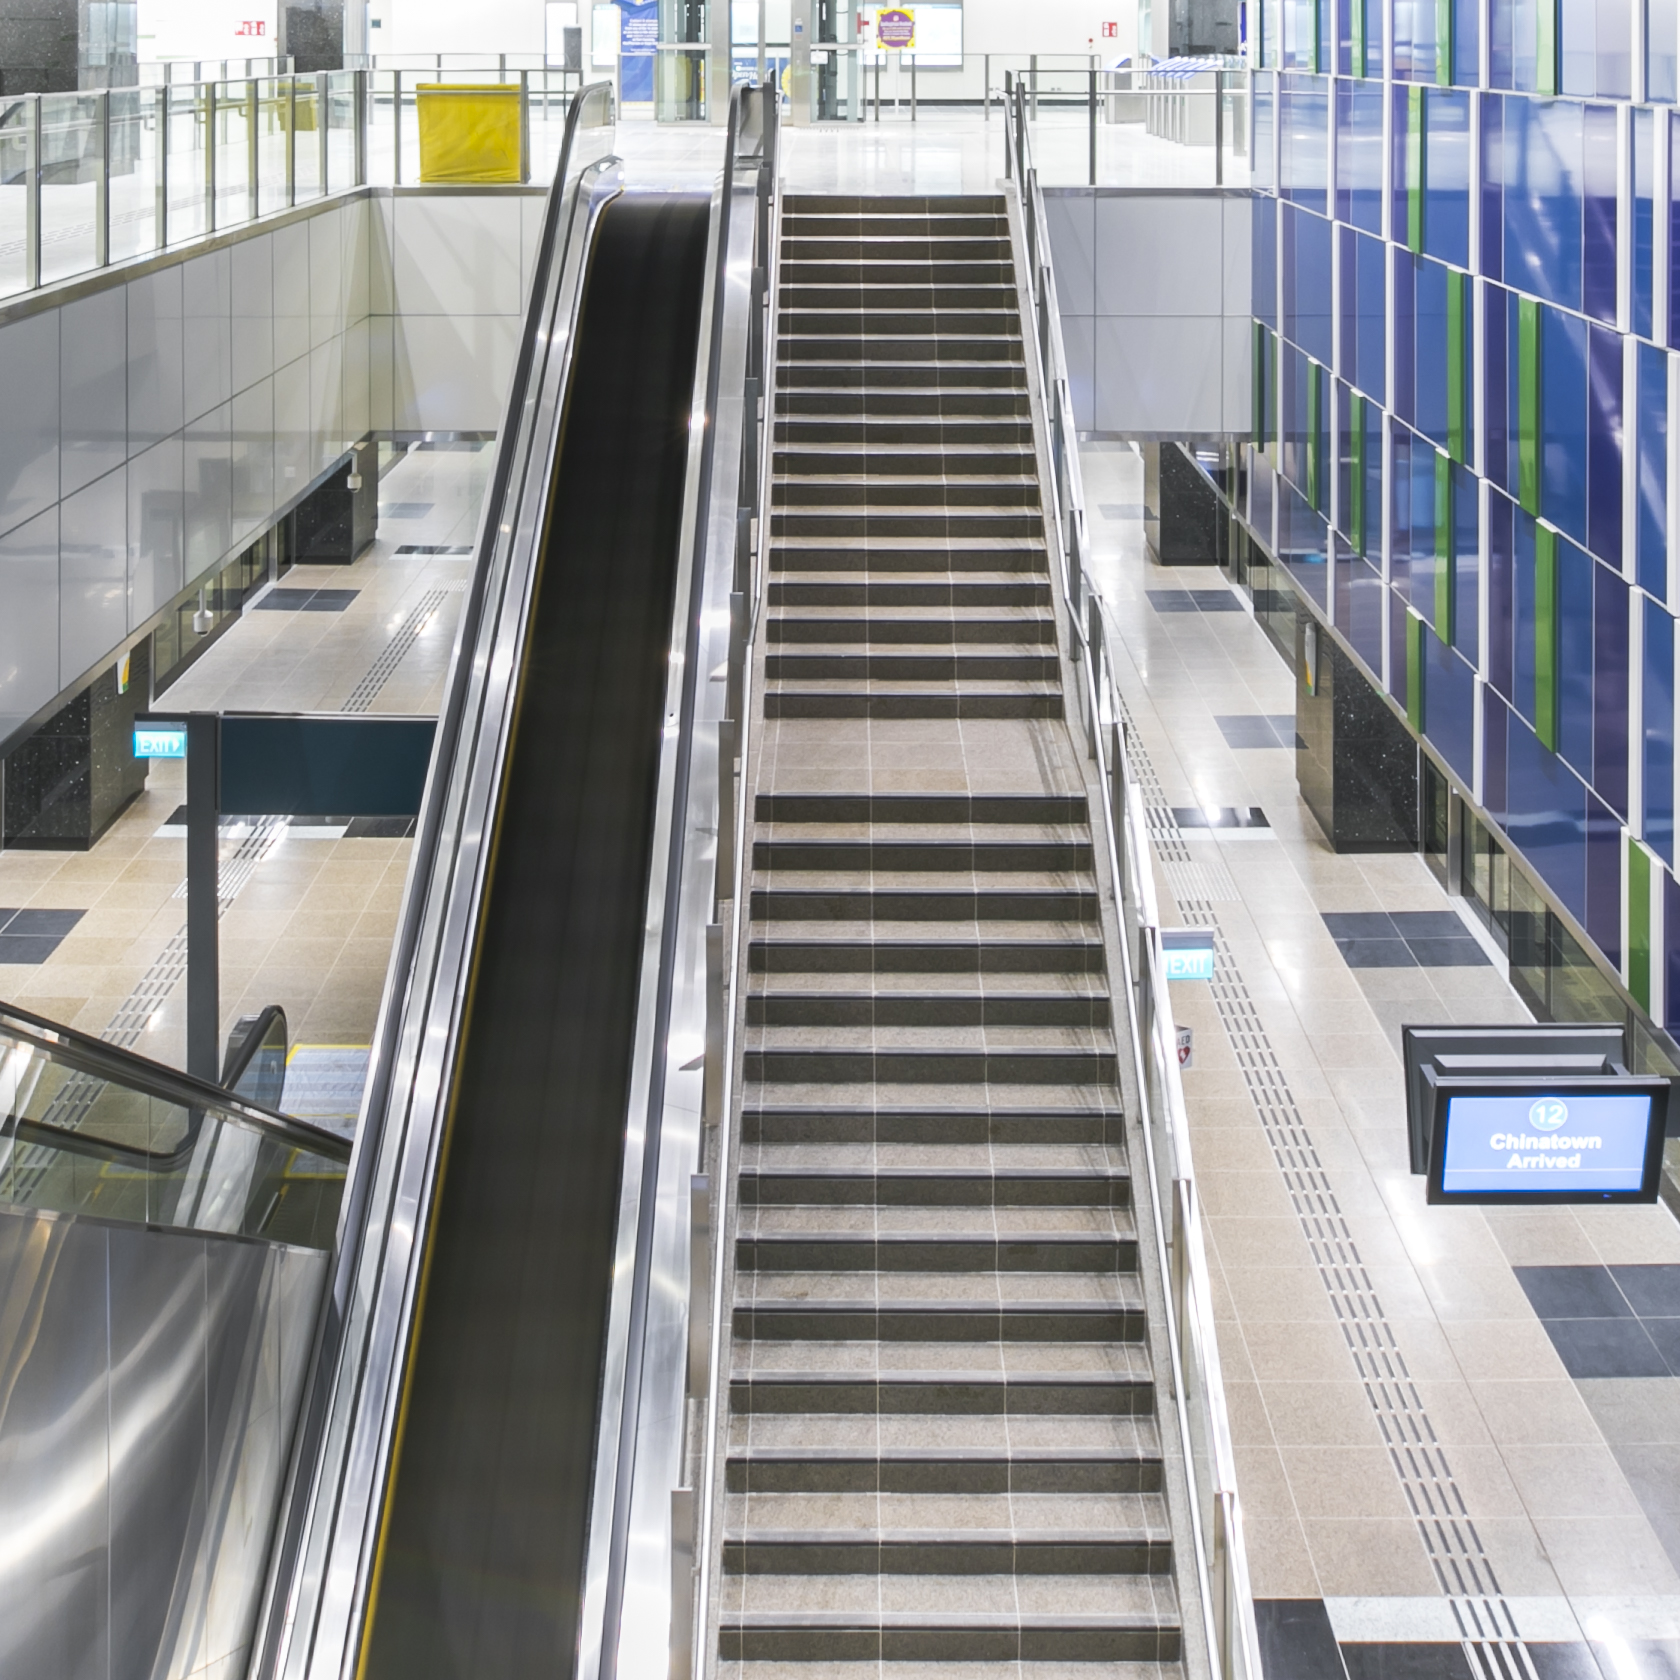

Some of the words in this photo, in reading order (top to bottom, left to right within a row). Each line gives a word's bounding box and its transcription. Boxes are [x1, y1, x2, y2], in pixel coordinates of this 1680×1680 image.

[139, 735, 171, 753] EXIT
[1170, 954, 1207, 974] EXIT
[1536, 1105, 1563, 1124] 12
[1490, 1133, 1602, 1150] Chinatown
[1507, 1153, 1581, 1169] Arrived
